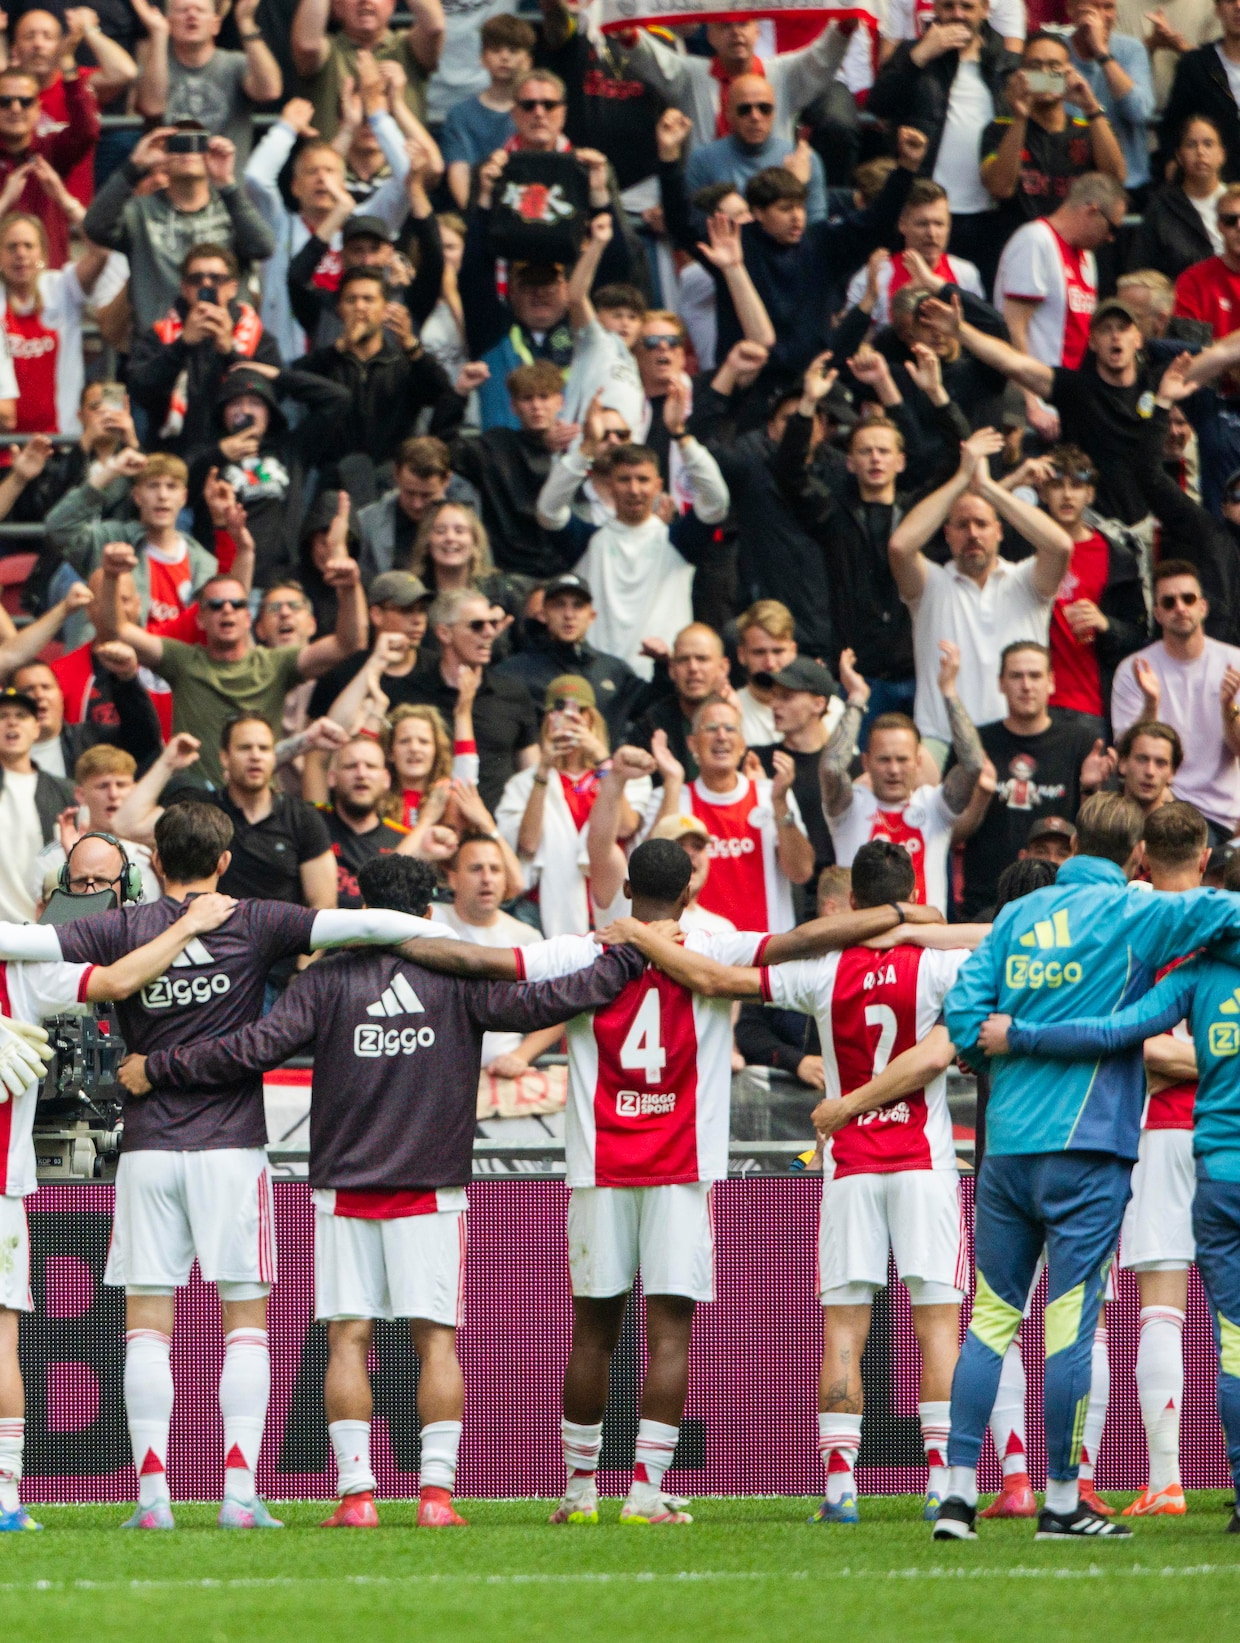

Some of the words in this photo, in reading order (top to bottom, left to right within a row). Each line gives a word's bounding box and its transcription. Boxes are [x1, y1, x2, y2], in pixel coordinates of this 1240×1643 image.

[141, 973, 231, 1009] Ziggo
[353, 1023, 436, 1058] Ziggo
[619, 987, 667, 1084] 4
[640, 1092, 677, 1105] ZIGGO
[640, 1102, 676, 1115] SPORT
